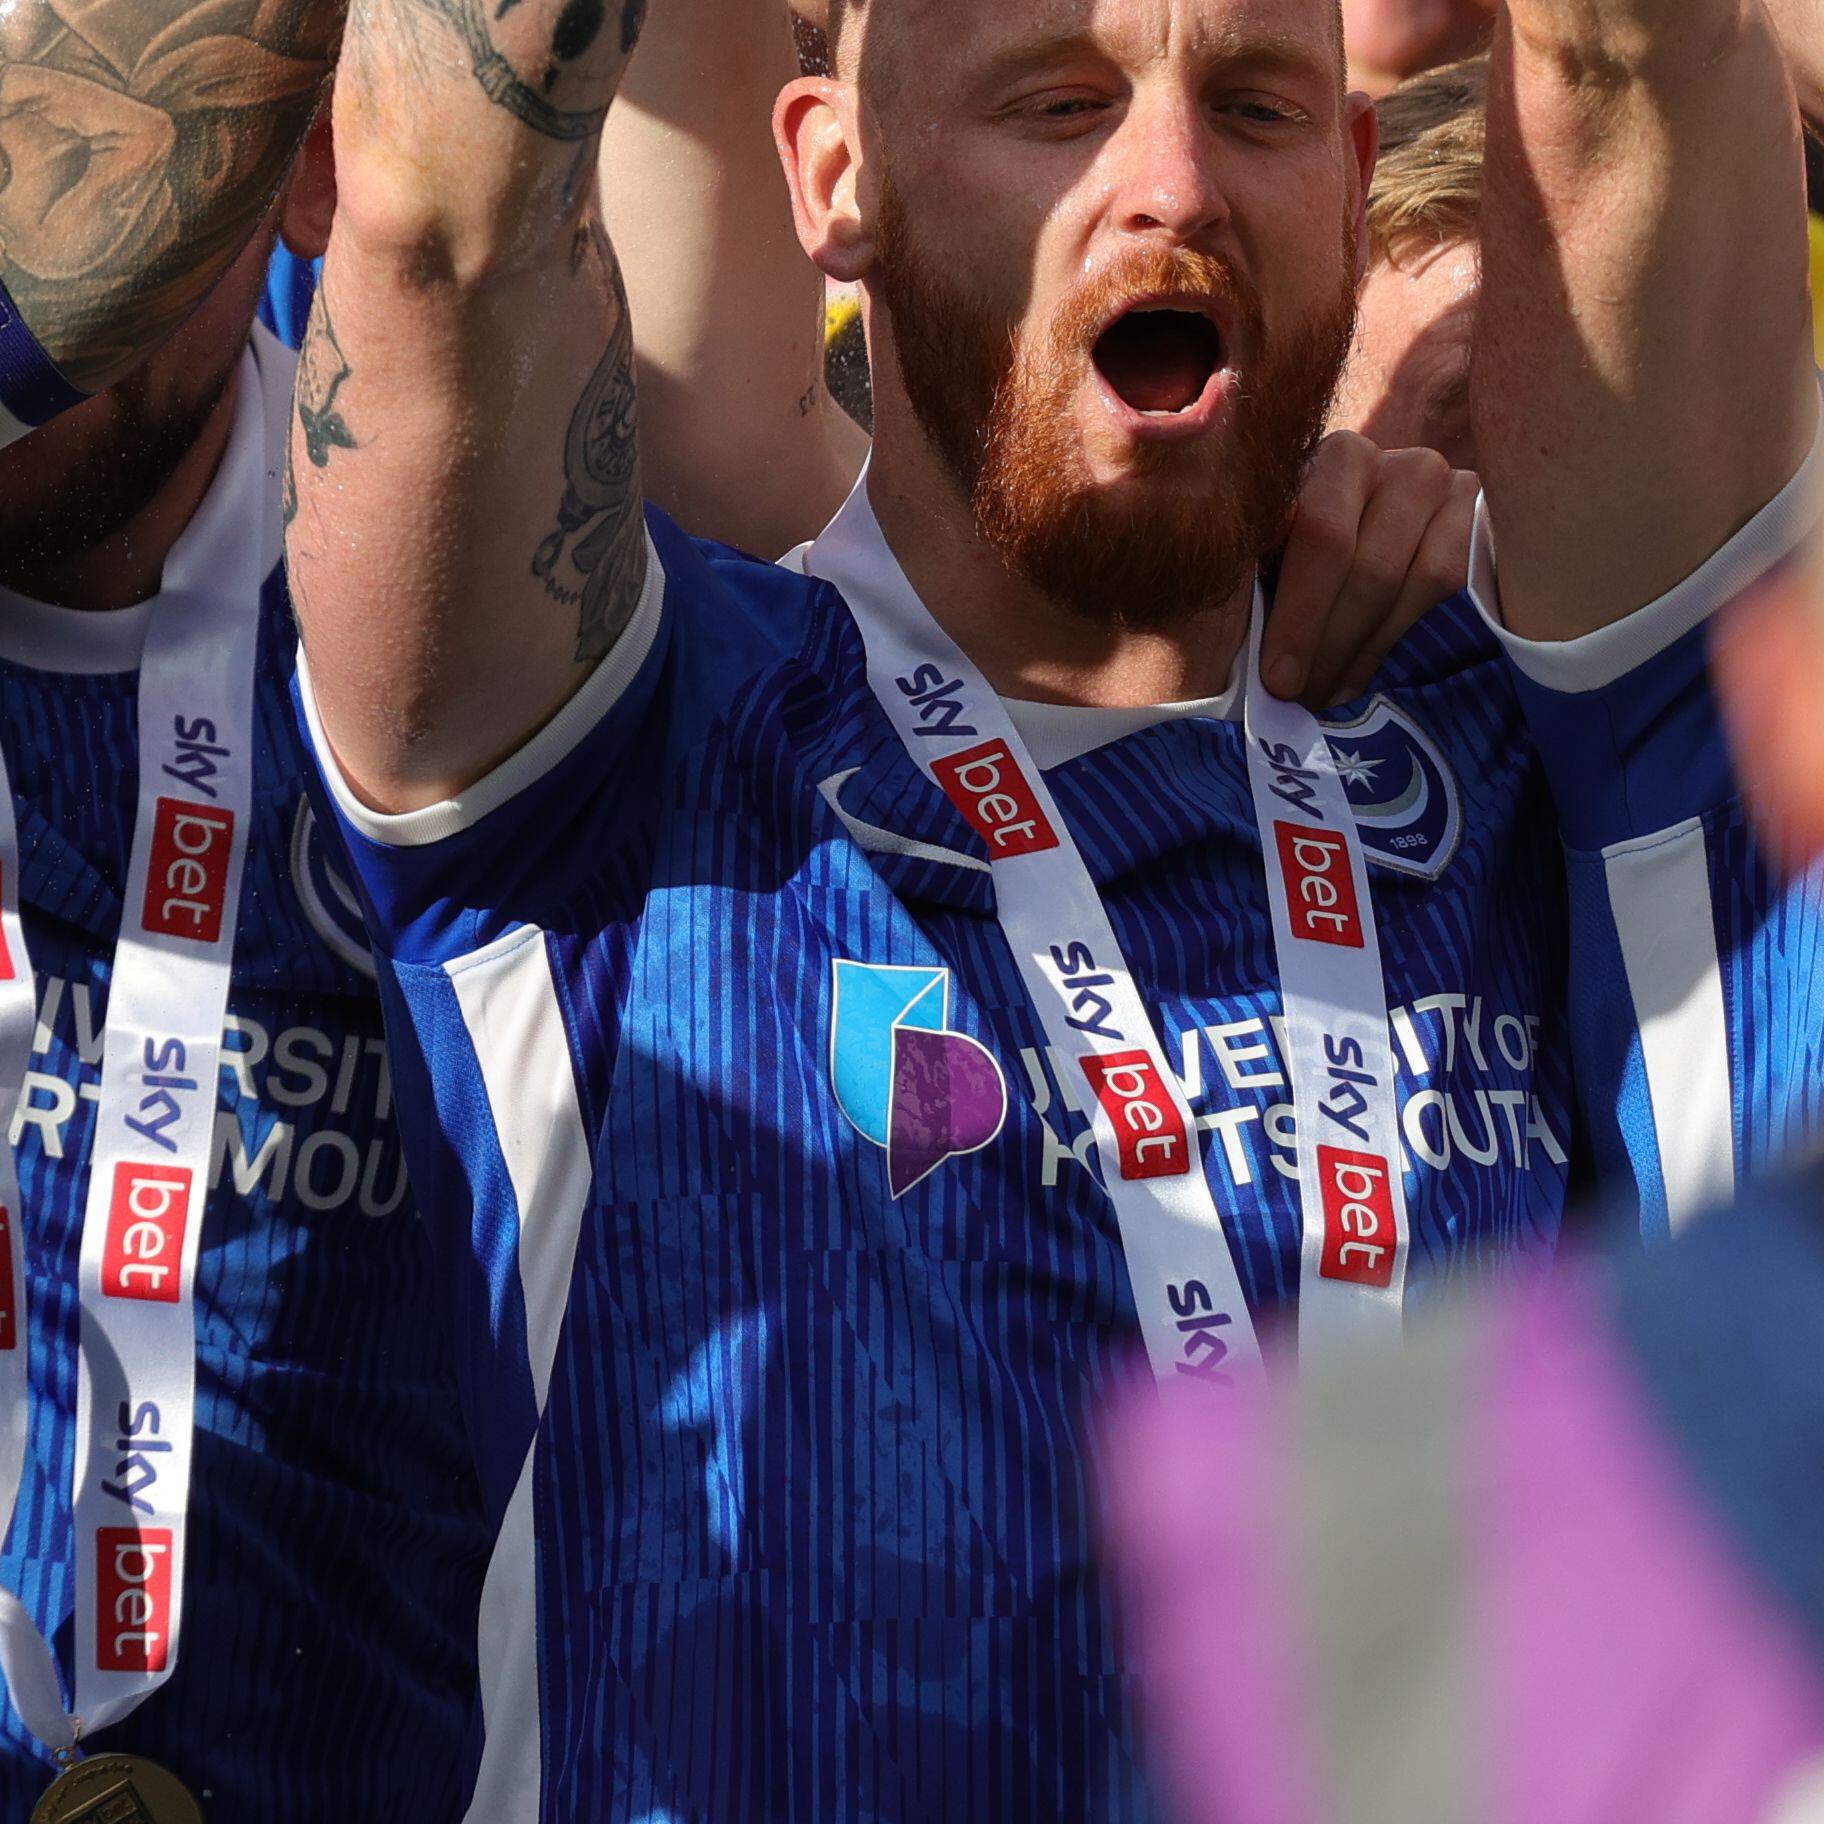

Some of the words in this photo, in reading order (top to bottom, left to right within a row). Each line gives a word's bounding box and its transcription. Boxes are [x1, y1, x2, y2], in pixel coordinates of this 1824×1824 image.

[161, 714, 231, 799] sky
[894, 662, 978, 737] sky
[953, 751, 1038, 849] bet
[1258, 736, 1325, 821] sky
[161, 811, 227, 926] bet
[1291, 835, 1349, 933] bet
[1389, 832, 1428, 851] 1898
[123, 1036, 198, 1155] sky
[1049, 939, 1126, 1042] sky
[1101, 1061, 1180, 1166] bet
[1317, 1032, 1378, 1143] sky
[1493, 1013, 1542, 1073] OF
[119, 1177, 186, 1290] bet
[1333, 1160, 1387, 1272] bet
[1166, 1278, 1235, 1387] sky
[100, 1400, 173, 1516] sky
[114, 1542, 167, 1669] bet
